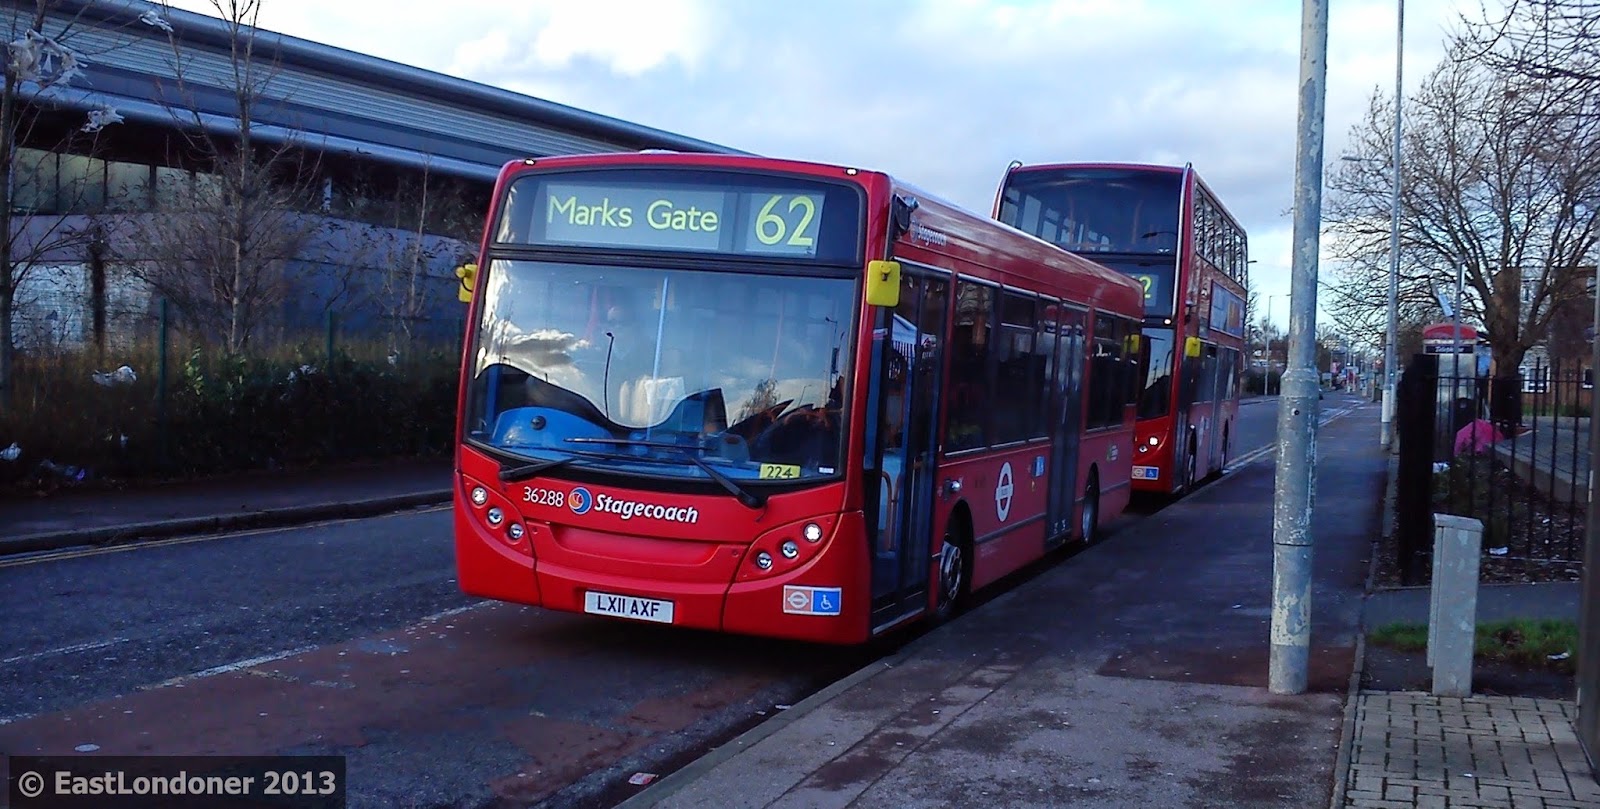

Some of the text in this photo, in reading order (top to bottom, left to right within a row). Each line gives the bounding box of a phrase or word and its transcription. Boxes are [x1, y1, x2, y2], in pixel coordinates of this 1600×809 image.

[547, 195, 719, 232] Marks Gate
[755, 195, 815, 246] 62
[1134, 275, 1152, 299] 2
[766, 465, 793, 479] 224
[522, 486, 698, 523] 36288 Stagecoach
[597, 595, 661, 617] LX11 AXF
